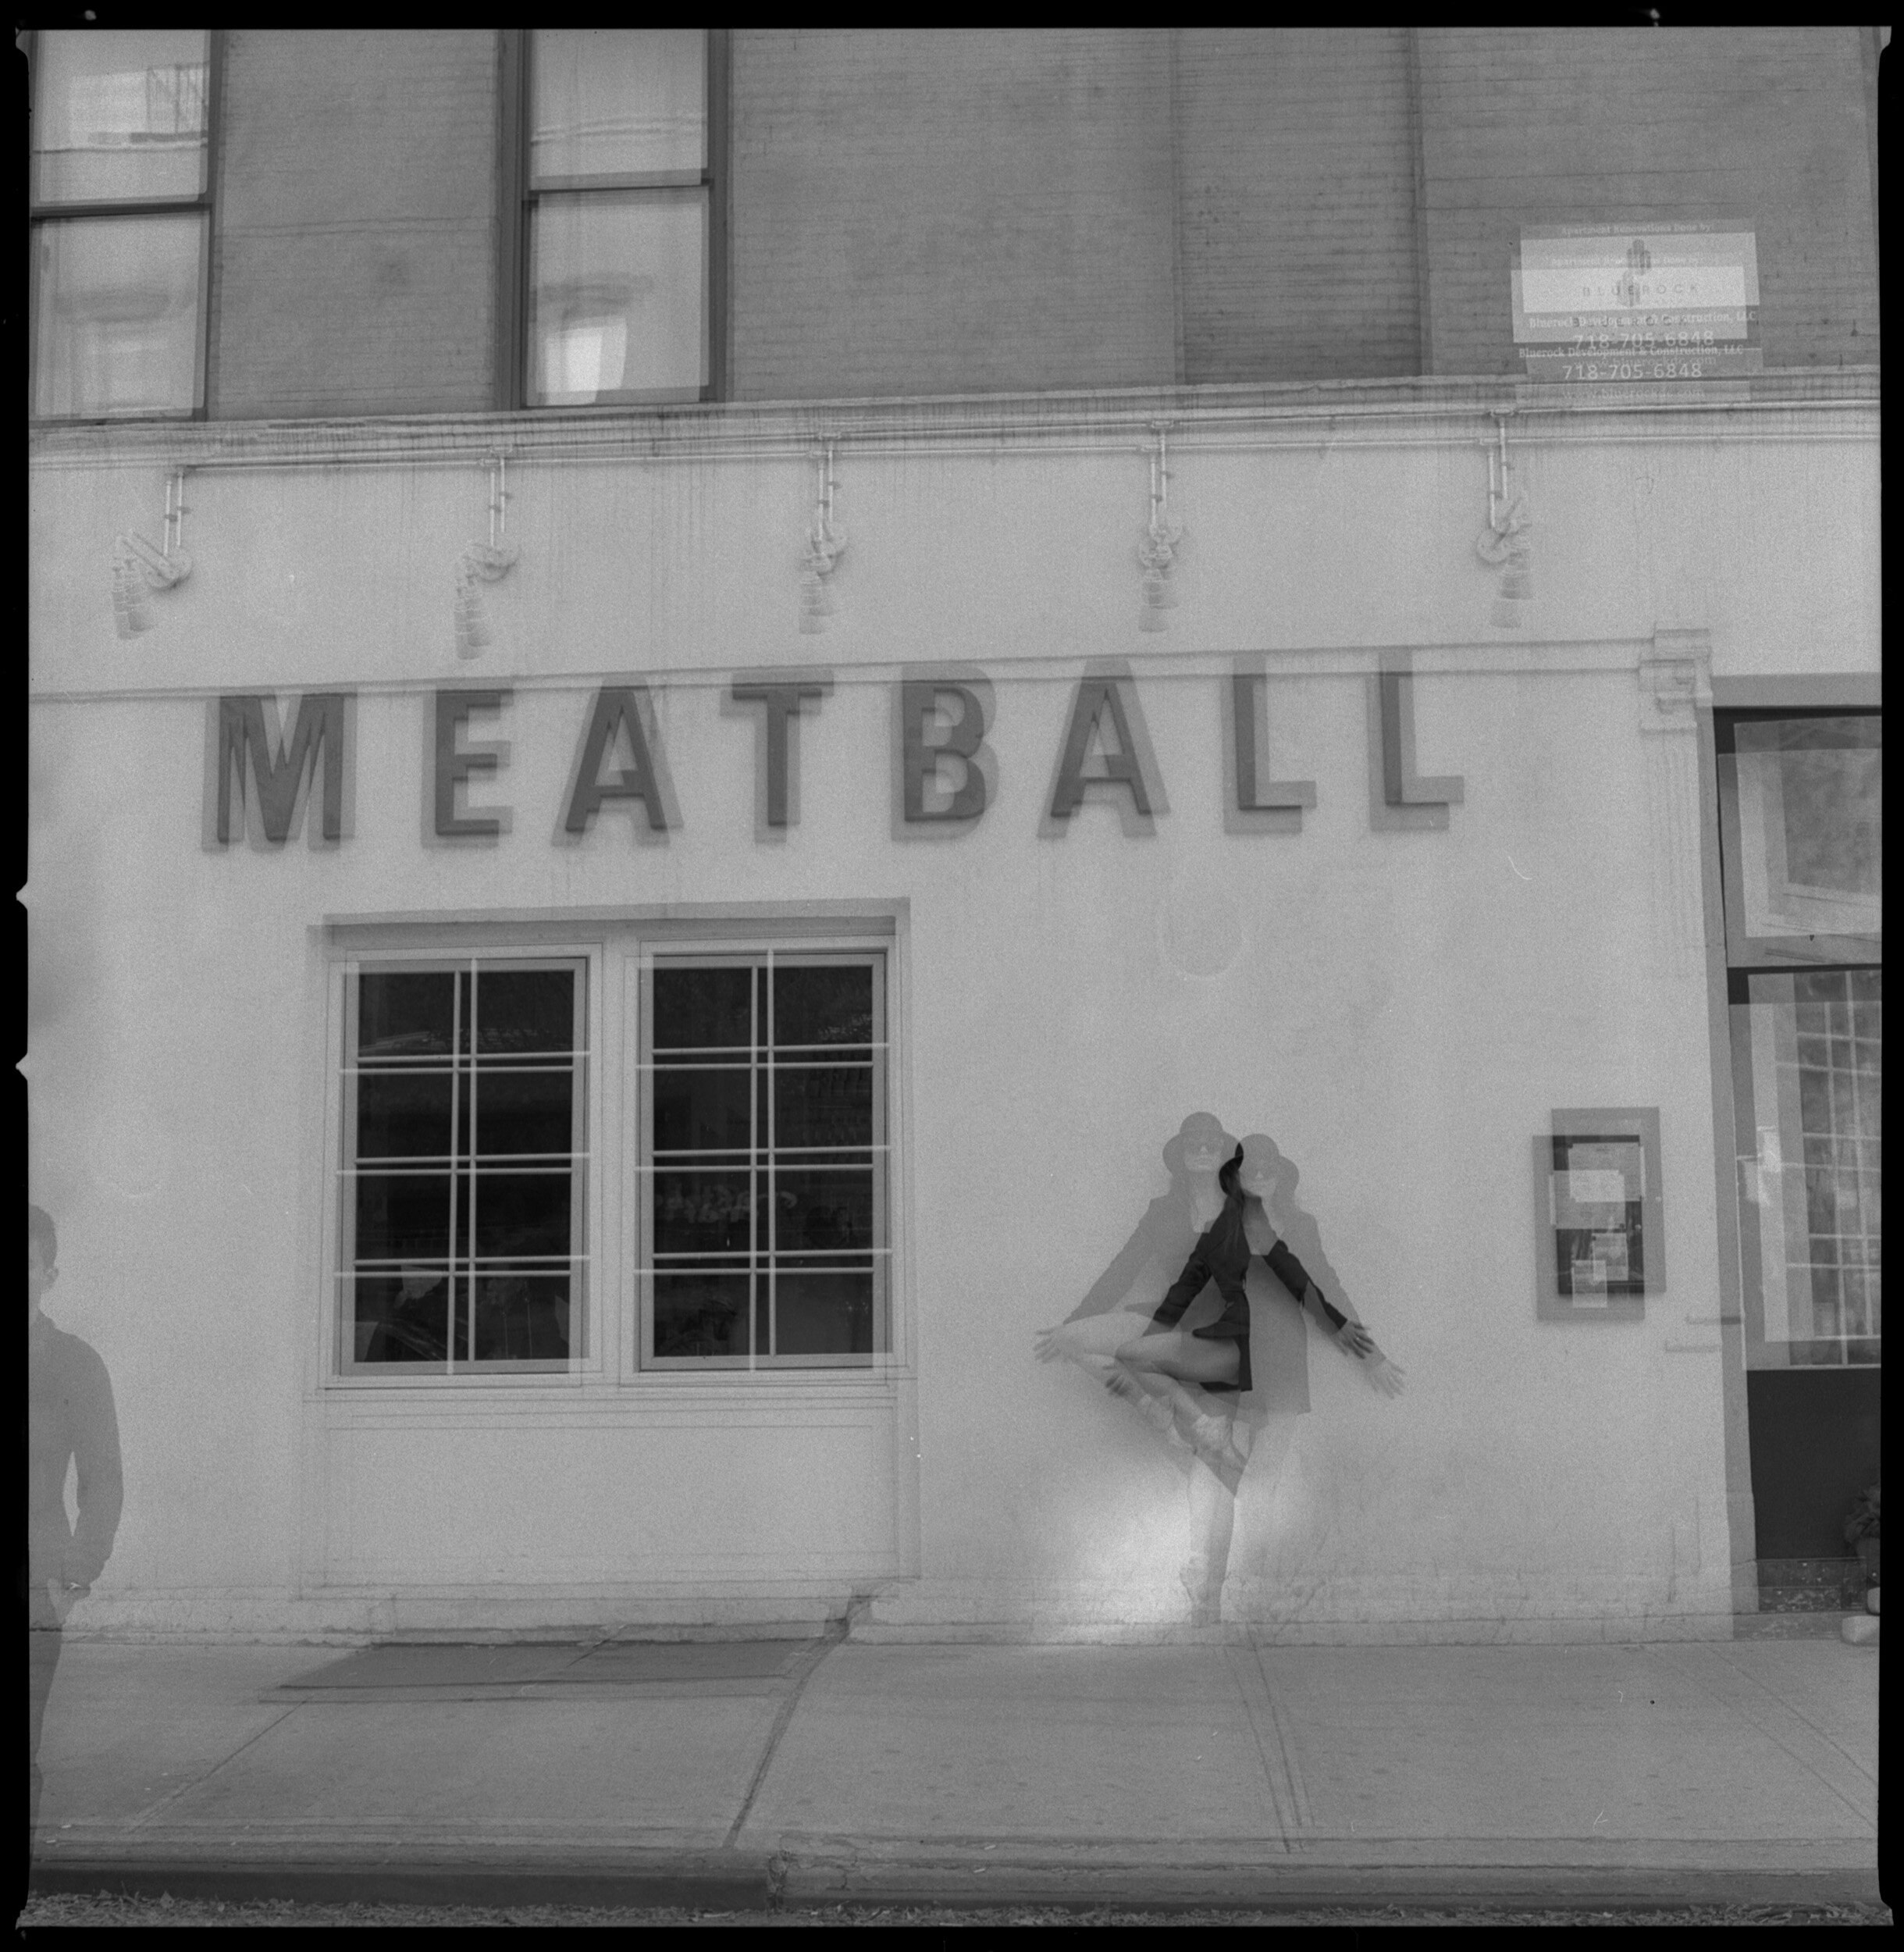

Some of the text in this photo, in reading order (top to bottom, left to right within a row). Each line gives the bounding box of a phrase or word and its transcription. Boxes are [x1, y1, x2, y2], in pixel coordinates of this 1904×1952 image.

[1582, 283, 1698, 297] BLUEROCK
[1573, 330, 1714, 350] 718-705-6848
[1562, 362, 1703, 380] 718-705-6848
[203, 647, 1464, 853] MEATBALL
